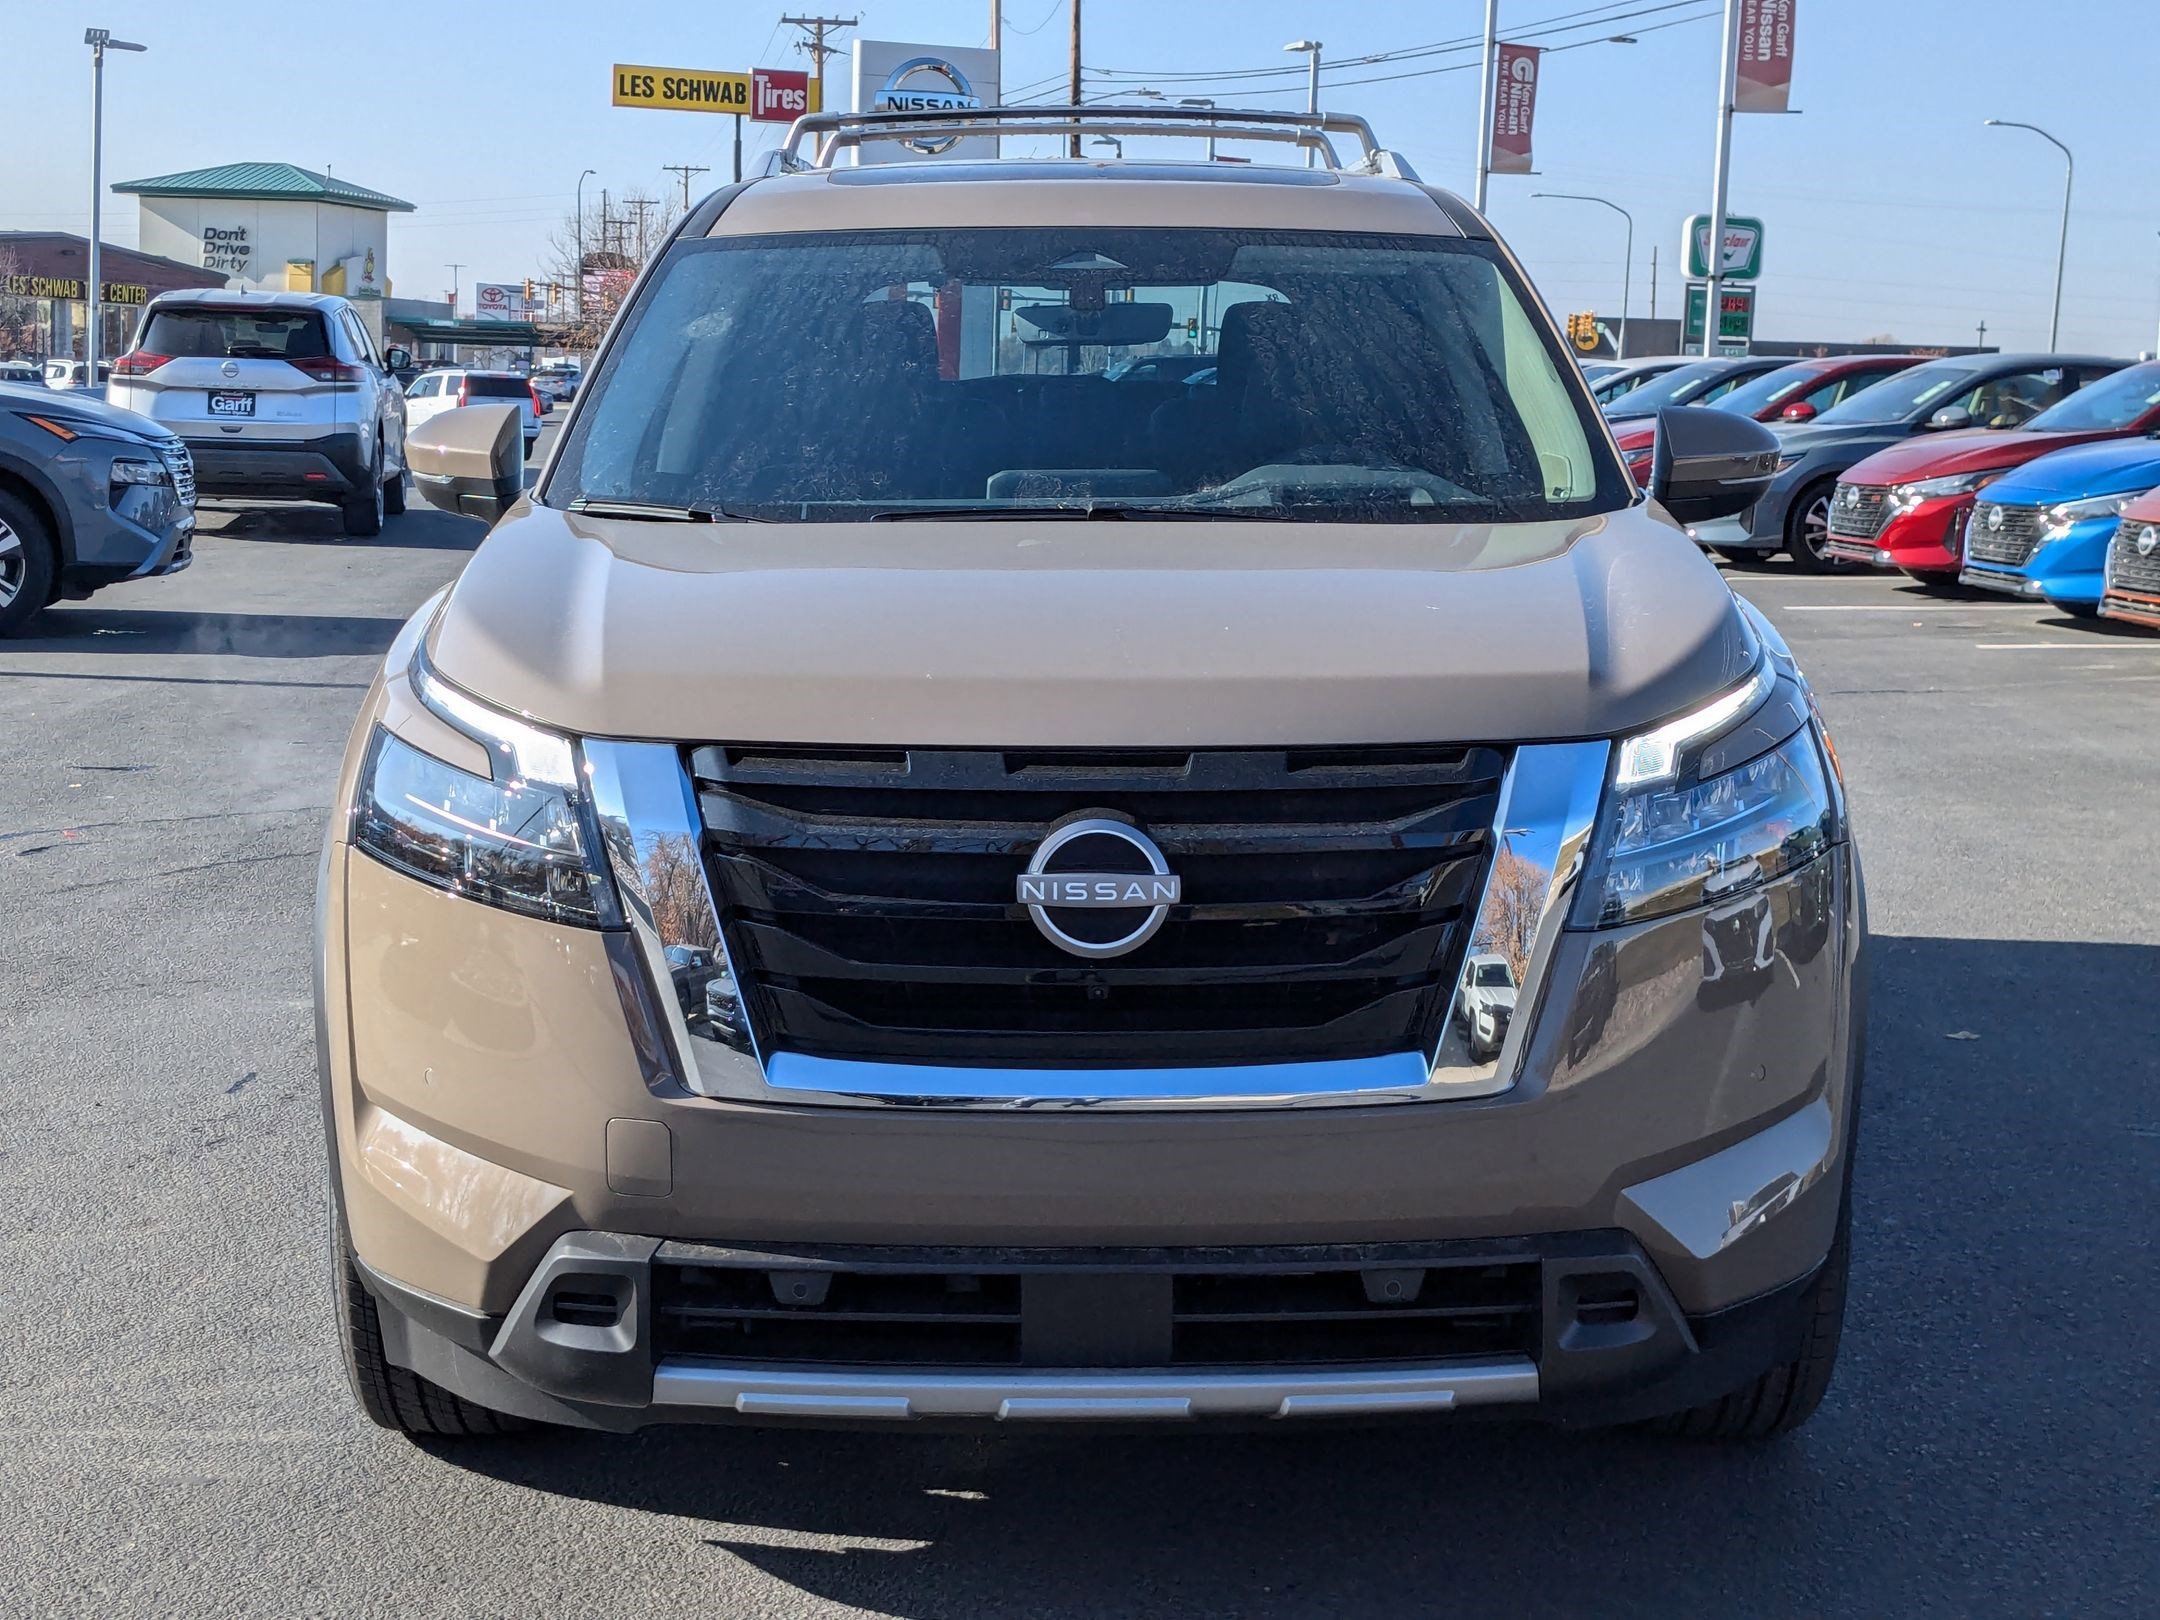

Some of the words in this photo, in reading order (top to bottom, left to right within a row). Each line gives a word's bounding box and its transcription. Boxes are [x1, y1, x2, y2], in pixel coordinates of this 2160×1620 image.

[1746, 0, 1757, 24] EAR
[1757, 0, 1778, 61] Nissan
[1775, 23, 1789, 57] Garff
[619, 74, 655, 98] LES
[662, 77, 747, 105] SCHWAB
[754, 74, 806, 116] Tires
[1521, 83, 1533, 105] Ken
[1508, 82, 1522, 135] Nissan
[203, 225, 247, 241] Don't
[1703, 232, 1751, 248] Sclair
[203, 242, 250, 256] Drive
[203, 256, 248, 272] Dirty
[31, 276, 78, 298] SCHWAB
[83, 281, 105, 300] TE
[110, 283, 147, 304] CENTER
[478, 303, 508, 311] TOYOTA
[211, 396, 253, 412] Garff
[1022, 880, 1175, 900] NISSAN
